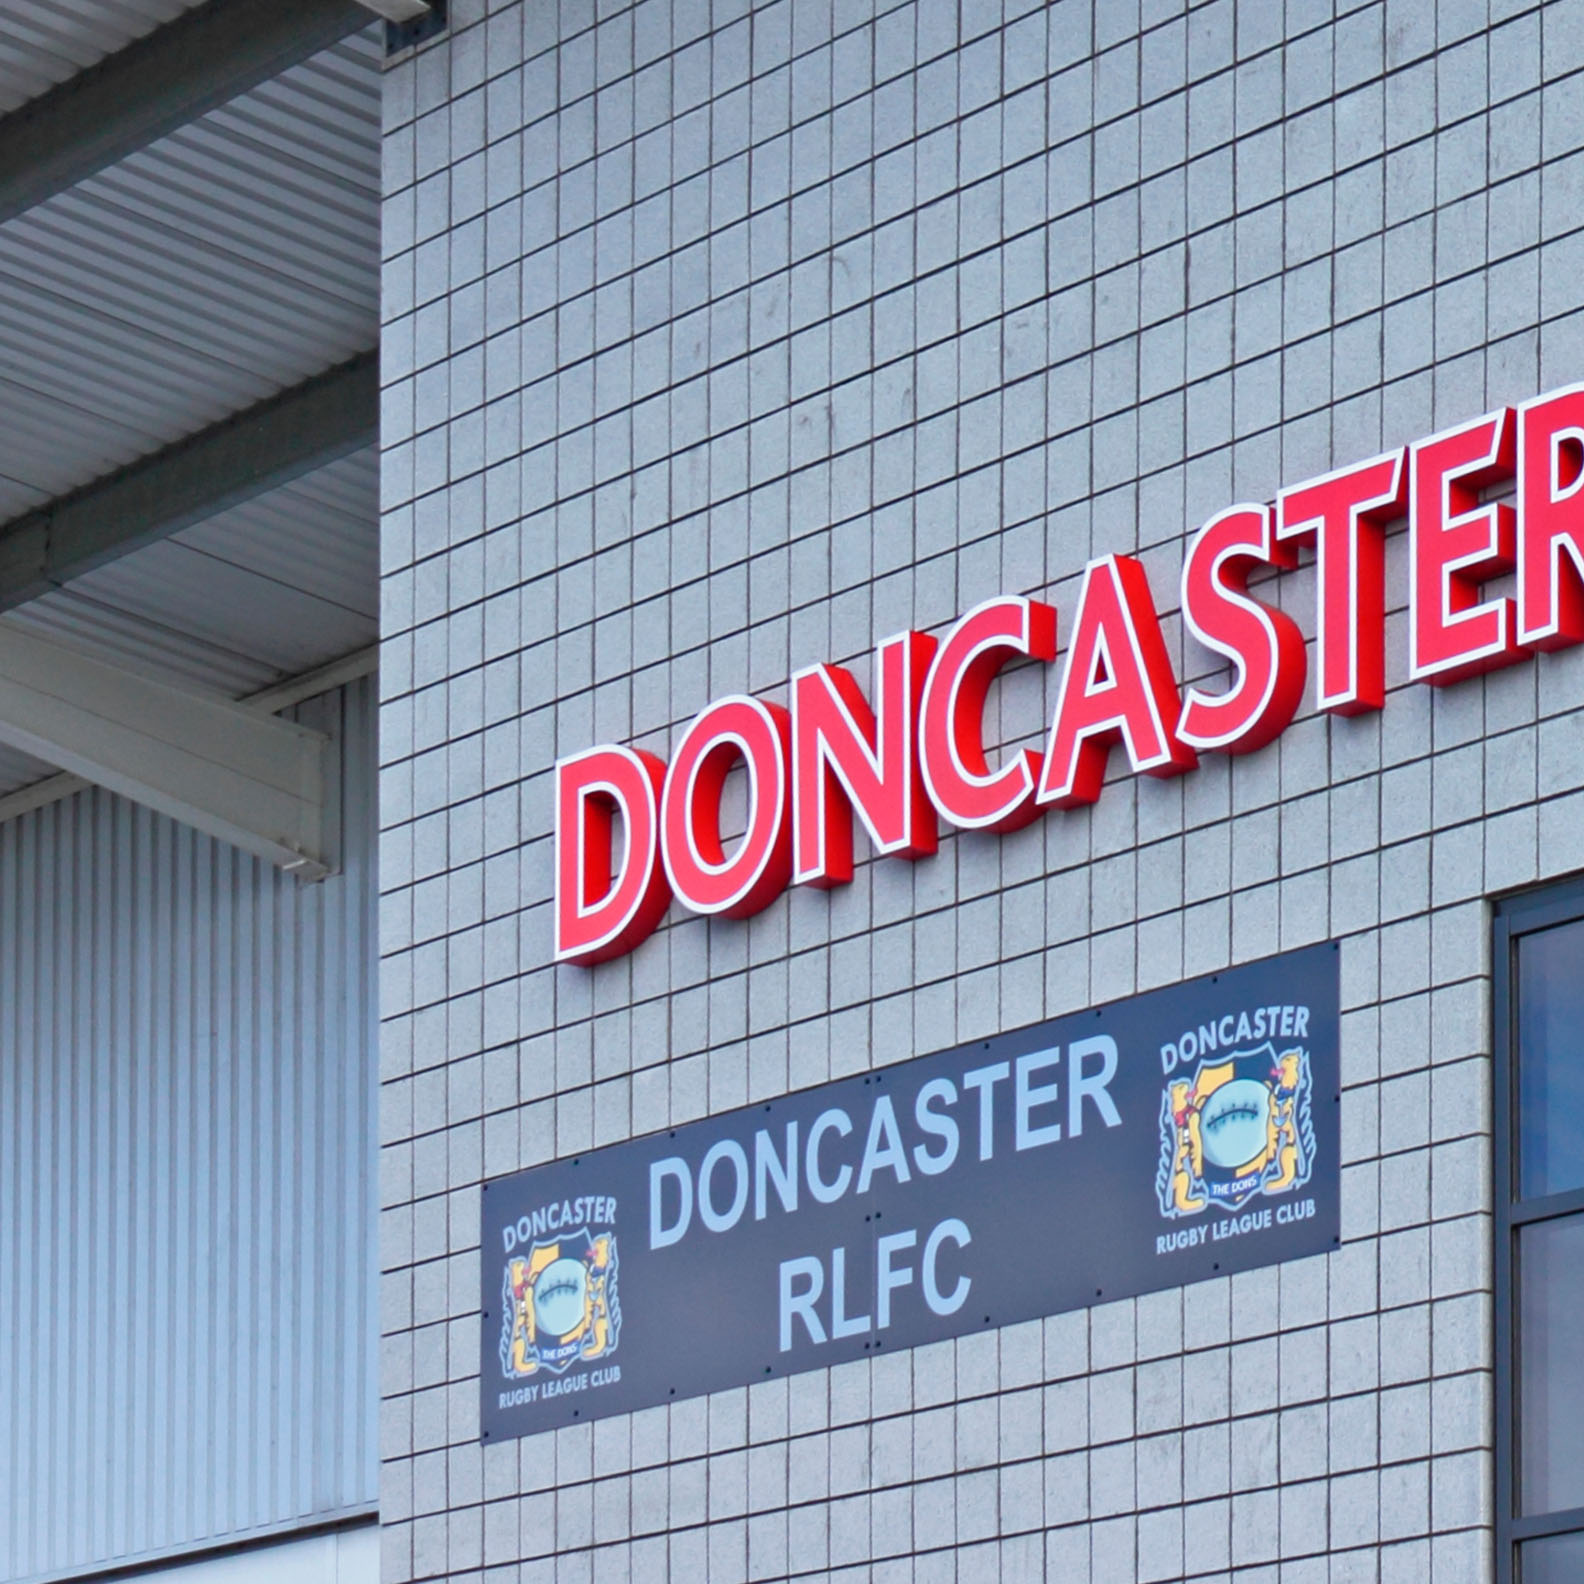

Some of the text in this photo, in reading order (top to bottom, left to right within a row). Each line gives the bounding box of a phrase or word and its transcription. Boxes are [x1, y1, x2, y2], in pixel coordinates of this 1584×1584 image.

[1160, 1005, 1311, 1075] DONCASTER
[648, 1033, 1124, 1250] DONCASTER
[1211, 1182, 1229, 1195] THE
[502, 1195, 618, 1253] DONCASTER
[1156, 1198, 1316, 1255] RUGBY LEAGUE CLUB
[779, 1218, 973, 1353] RLFC
[498, 1364, 622, 1410] RUGBY LEAGUE CLUB
